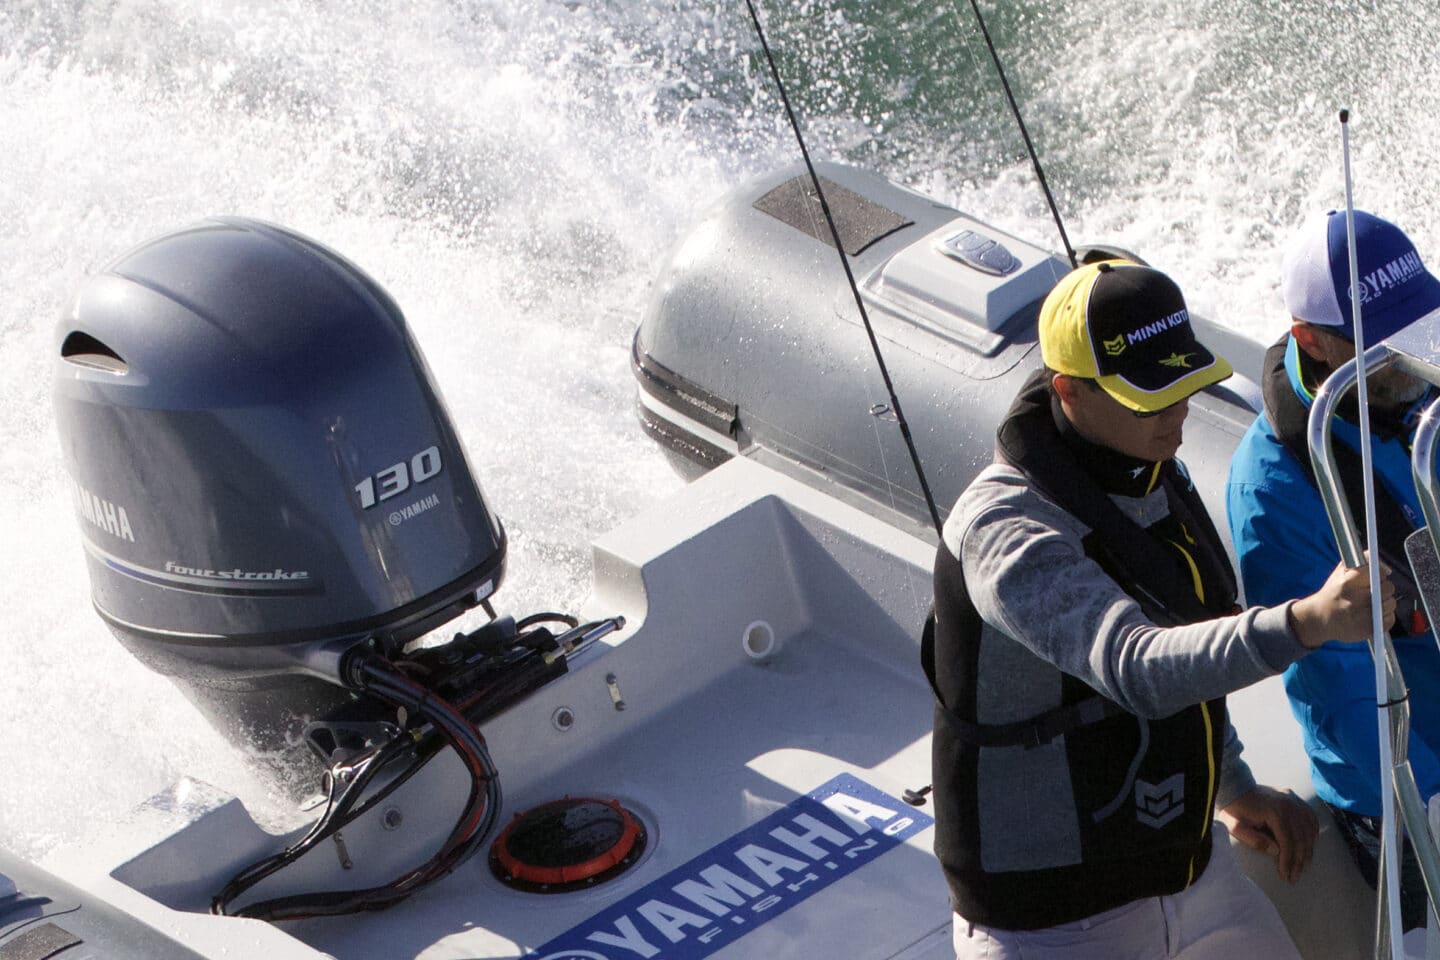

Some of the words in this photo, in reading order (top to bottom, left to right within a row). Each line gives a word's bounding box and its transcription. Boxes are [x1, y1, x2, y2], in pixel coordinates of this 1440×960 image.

[1126, 318, 1168, 345] MINN
[1167, 308, 1189, 328] KOT
[355, 446, 442, 509] 130
[400, 493, 440, 520] YAMAHA
[77, 484, 135, 543] MAHA
[587, 791, 899, 960] YAMAHA
[697, 817, 915, 945] FISHING
